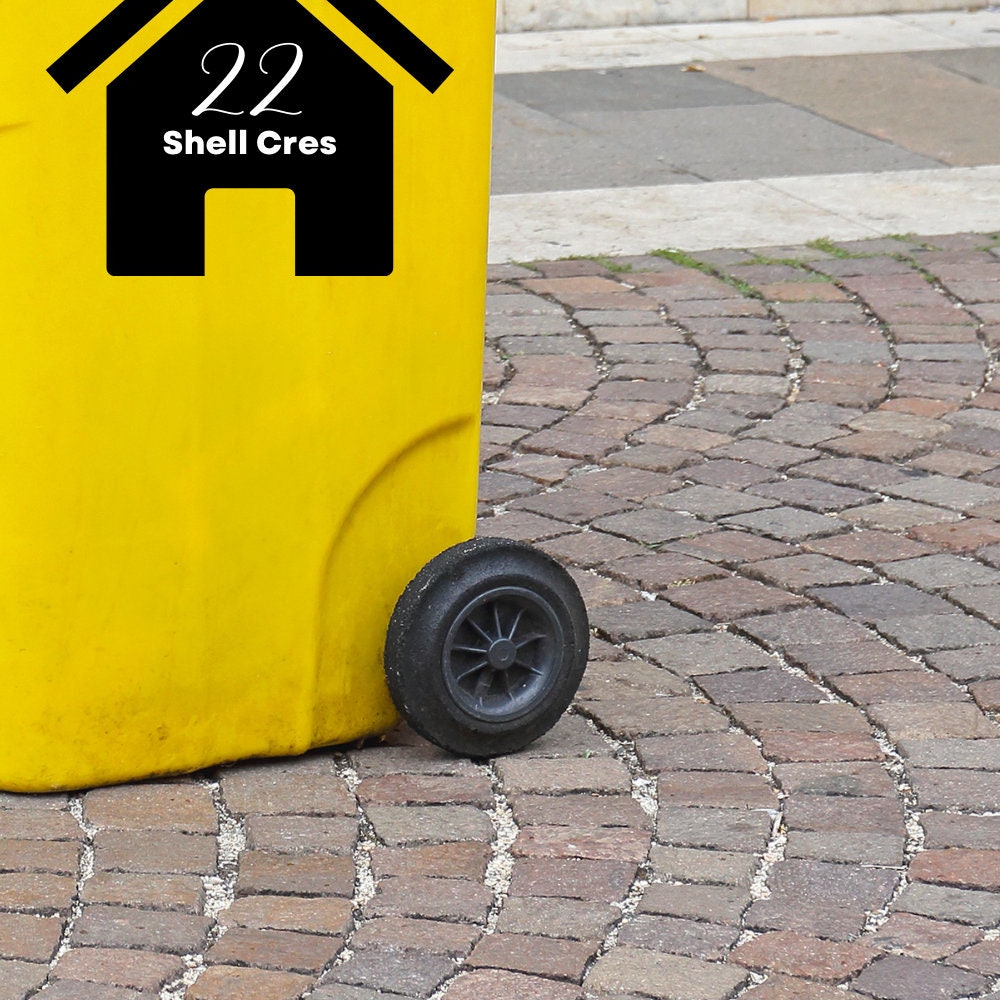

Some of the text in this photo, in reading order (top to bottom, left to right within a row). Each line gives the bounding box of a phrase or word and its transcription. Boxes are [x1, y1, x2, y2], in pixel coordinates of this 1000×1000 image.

[191, 42, 304, 117] 22
[163, 129, 337, 156] Shell Cres
